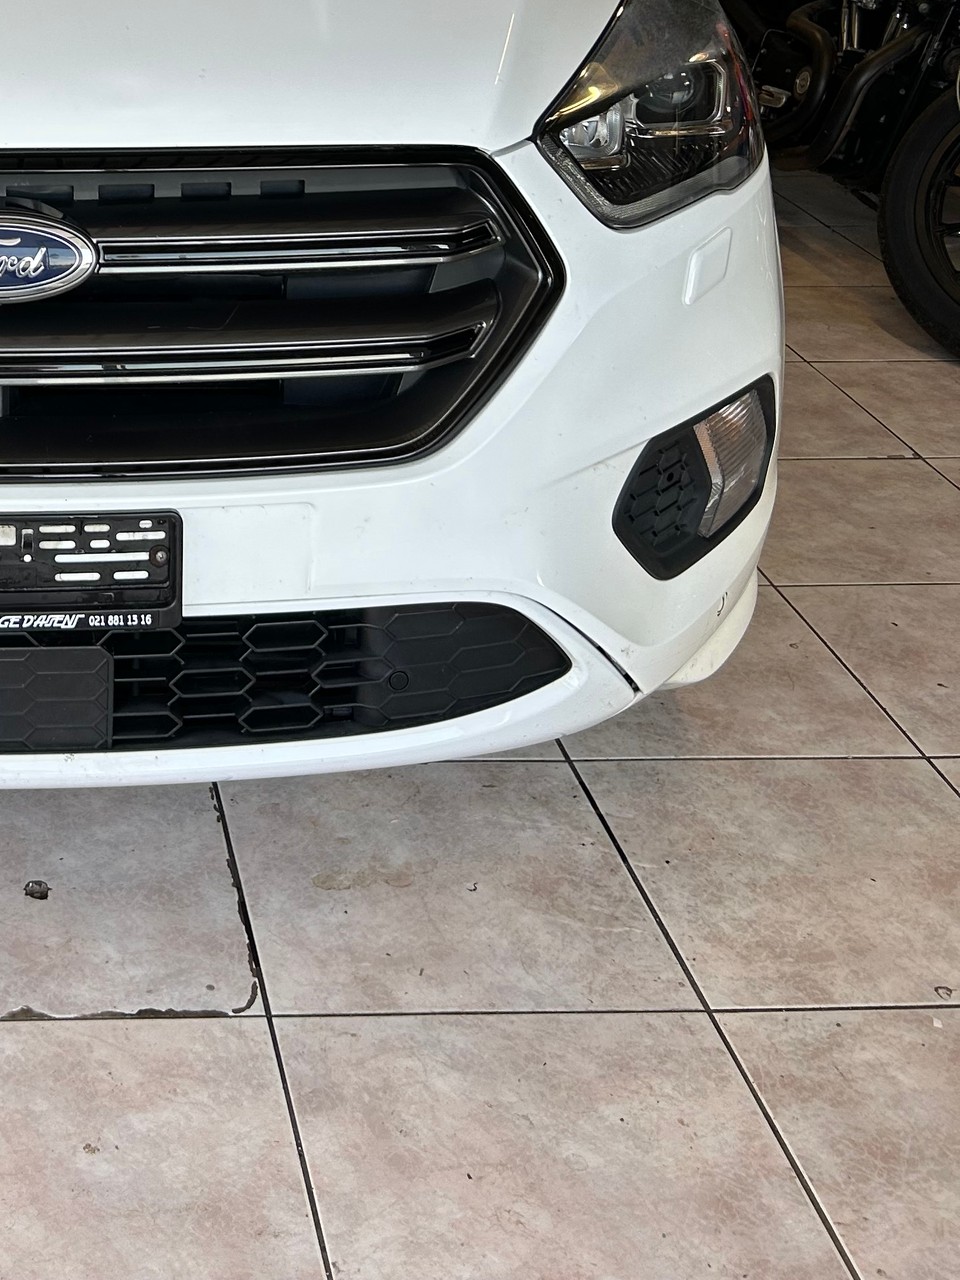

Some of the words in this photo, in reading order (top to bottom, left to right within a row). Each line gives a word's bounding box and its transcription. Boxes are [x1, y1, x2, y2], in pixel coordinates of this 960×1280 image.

[89, 615, 106, 626] 021
[108, 615, 125, 626] 881
[140, 614, 152, 625] 16
